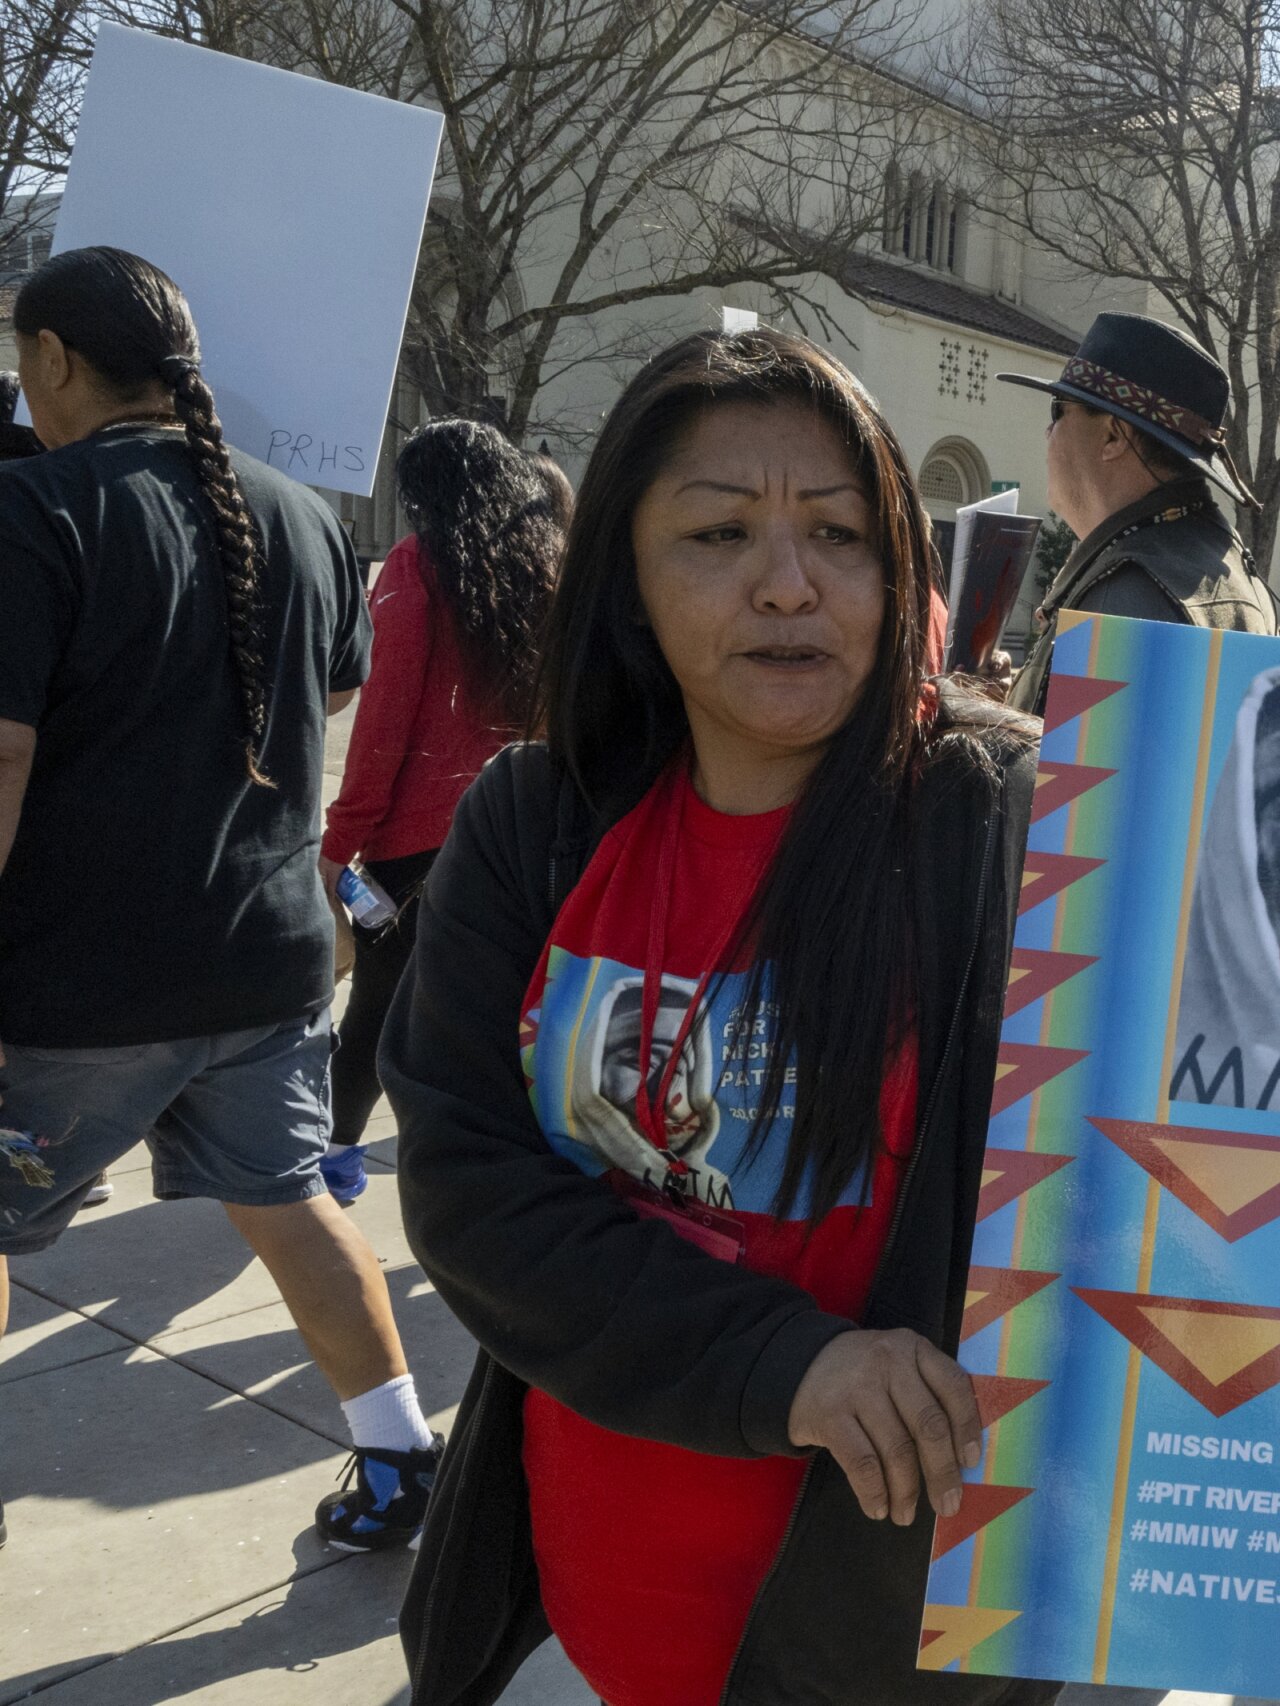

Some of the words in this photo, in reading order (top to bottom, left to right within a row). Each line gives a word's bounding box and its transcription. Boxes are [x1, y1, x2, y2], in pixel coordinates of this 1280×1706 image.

[266, 429, 365, 473] PRHS
[1146, 1431, 1274, 1465] MISSING
[1136, 1479, 1202, 1507] #PIT
[1129, 1519, 1239, 1550] #MMIW
